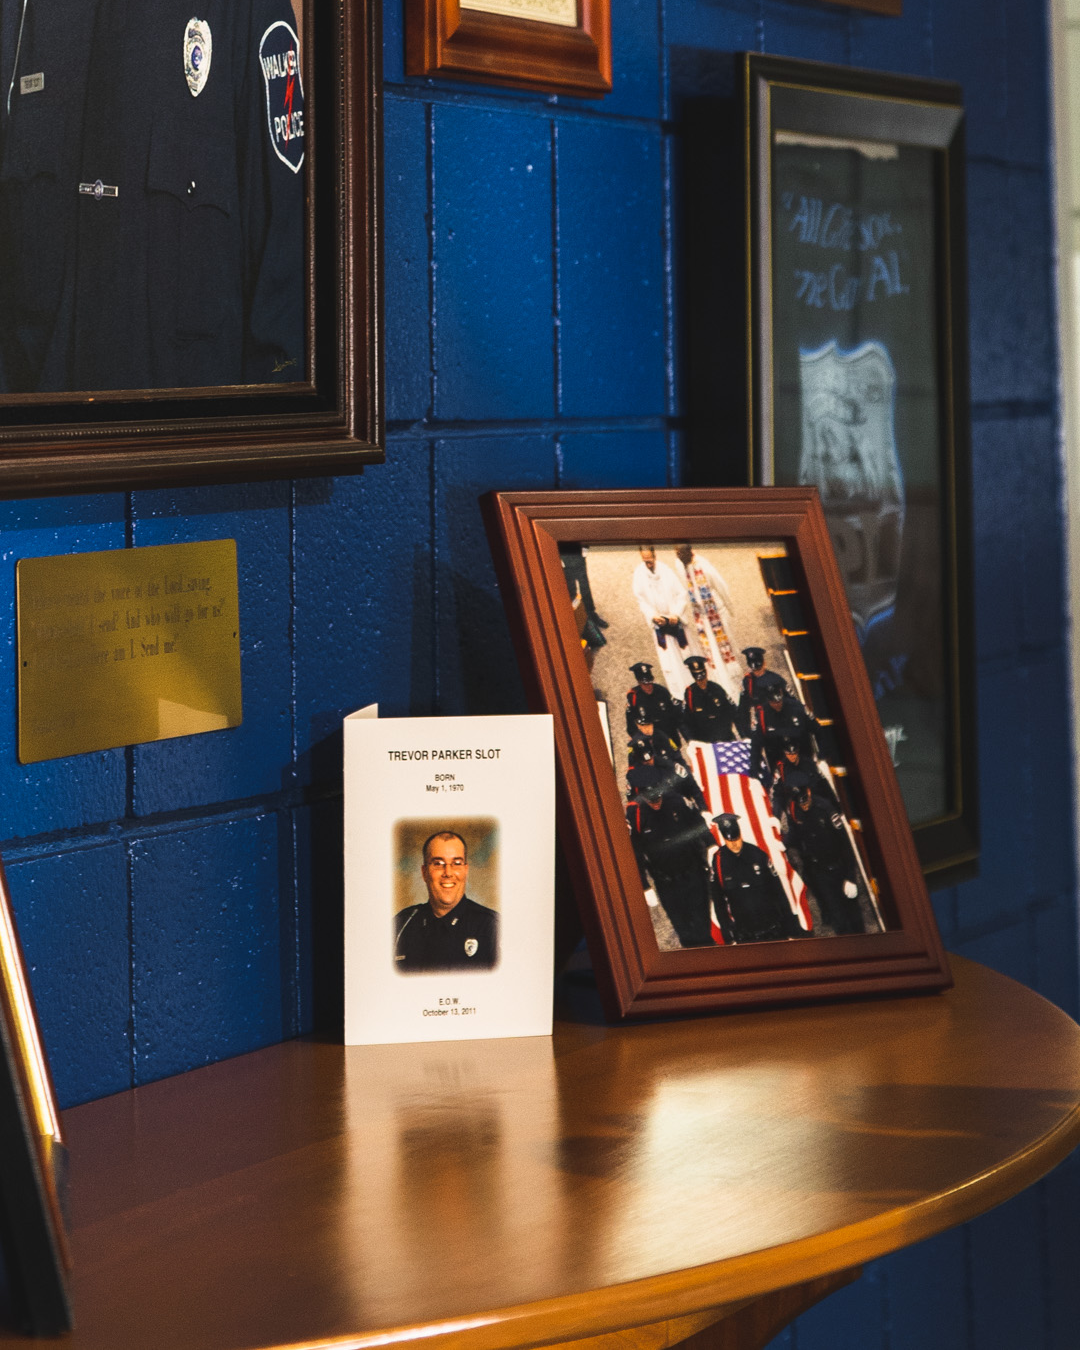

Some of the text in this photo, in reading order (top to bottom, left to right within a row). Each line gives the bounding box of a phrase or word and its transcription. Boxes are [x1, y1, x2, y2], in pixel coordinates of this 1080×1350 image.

[274, 110, 305, 143] POLICE
[388, 749, 501, 761] TREVOR PARKER SLOT
[434, 774, 456, 782] BORN
[425, 785, 439, 793] May
[449, 784, 464, 792] 1970
